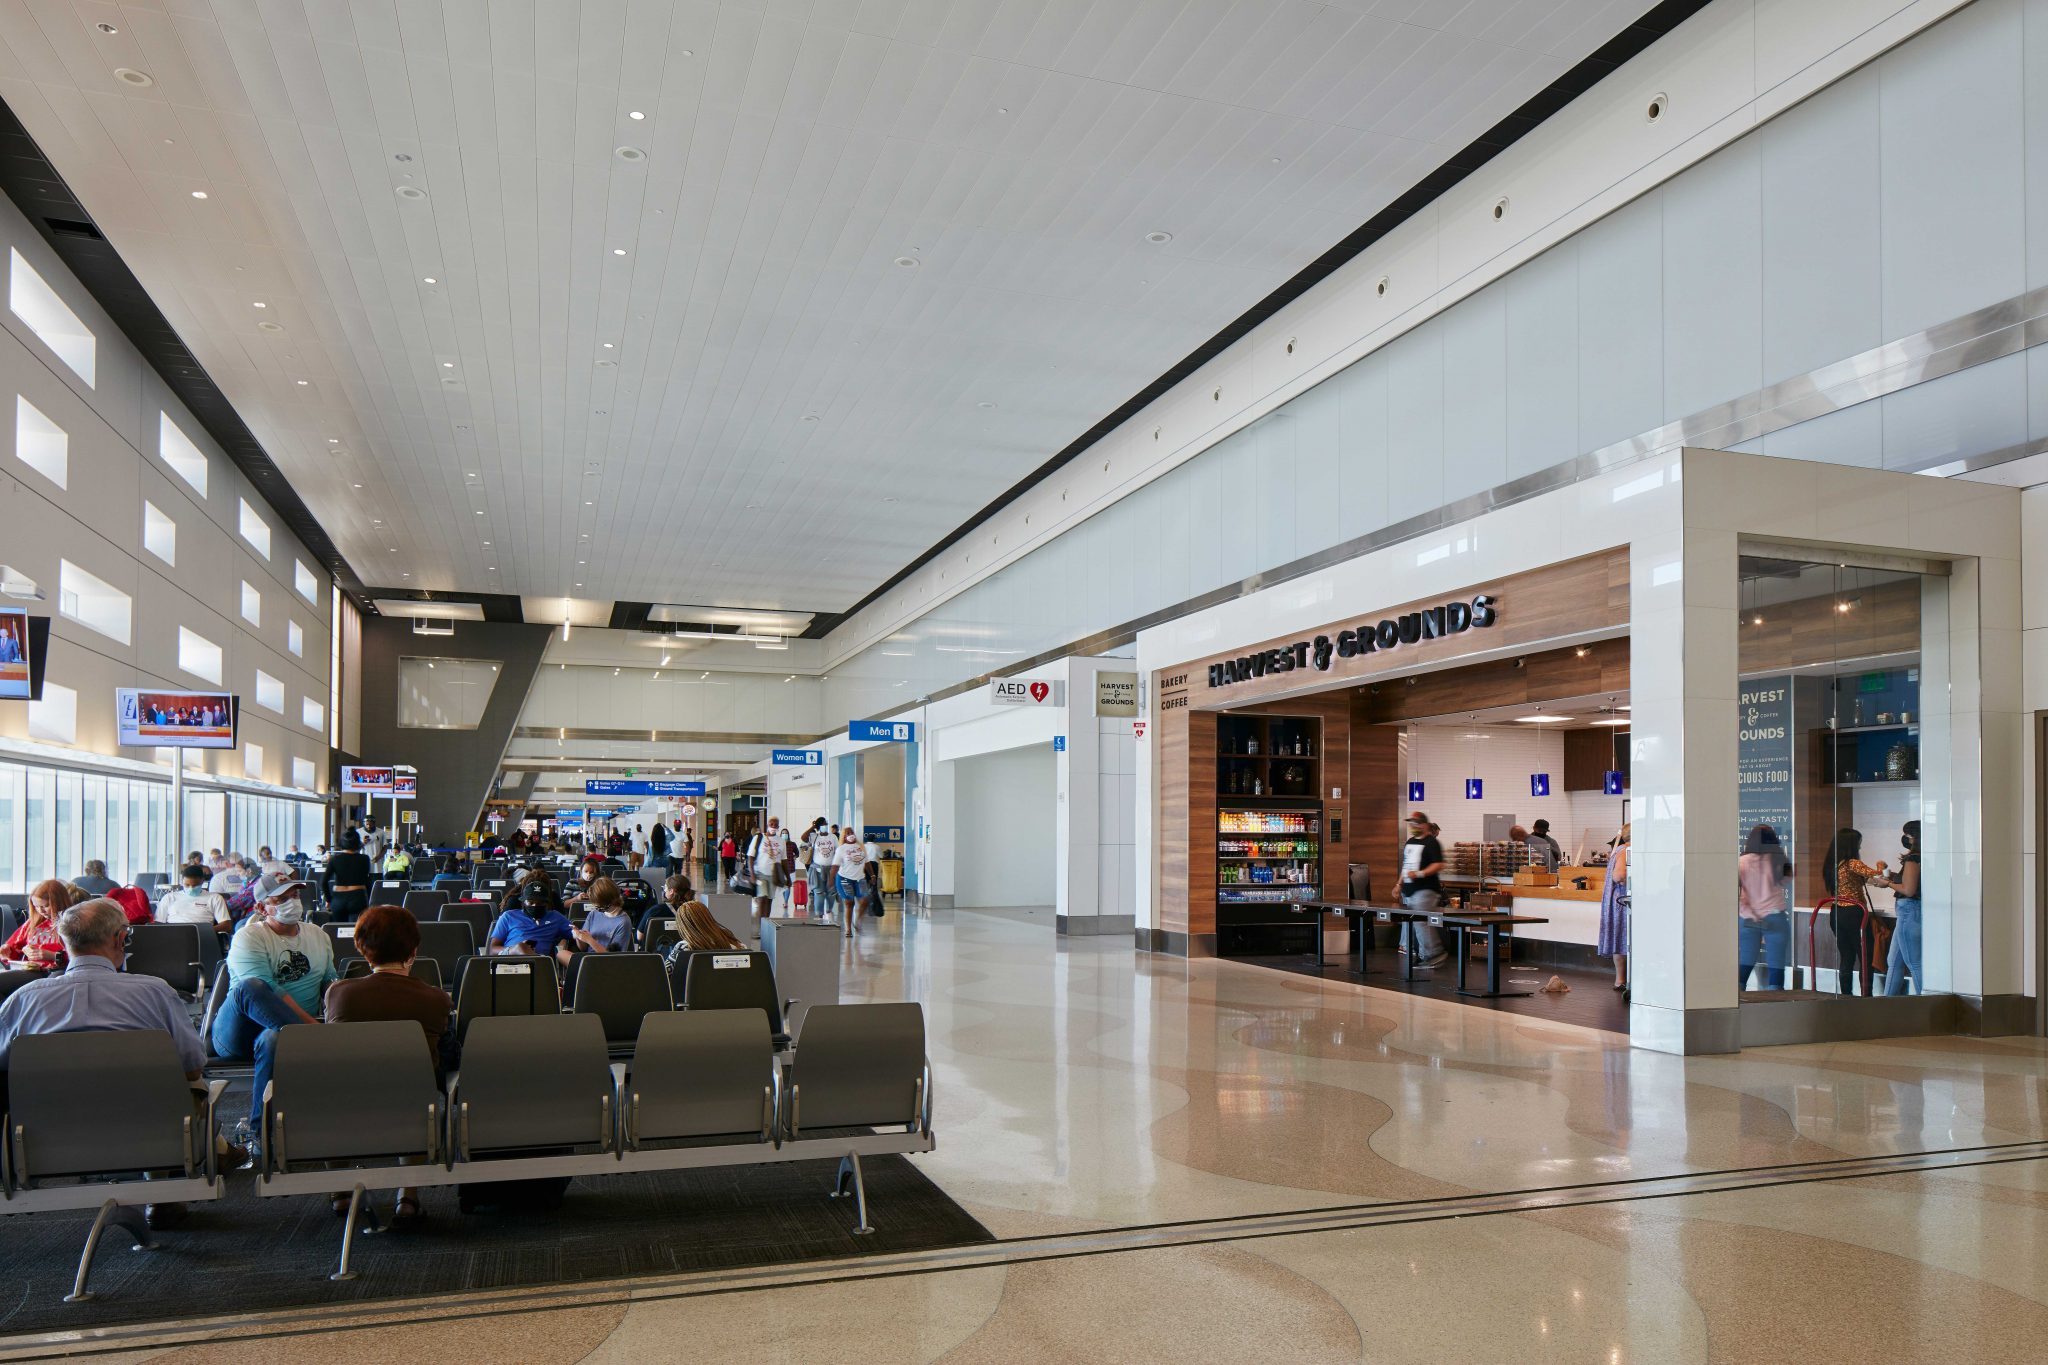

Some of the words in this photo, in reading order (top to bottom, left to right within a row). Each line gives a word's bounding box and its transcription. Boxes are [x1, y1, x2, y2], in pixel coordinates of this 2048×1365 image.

[1208, 642, 1310, 688] HARVEST
[1313, 635, 1333, 671] &
[1336, 595, 1497, 658] GROUNDS
[1161, 674, 1188, 688] BAKERY
[997, 683, 1026, 694] AED
[1739, 689, 1785, 704] RVEST
[1161, 697, 1188, 710] COFFEE
[1747, 708, 1759, 726] &
[869, 726, 891, 736] Men
[1740, 727, 1785, 740] OUNDS
[1738, 772, 1763, 783] CIOUS
[1766, 770, 1788, 782] FOOD
[1760, 815, 1788, 823] TASTY
